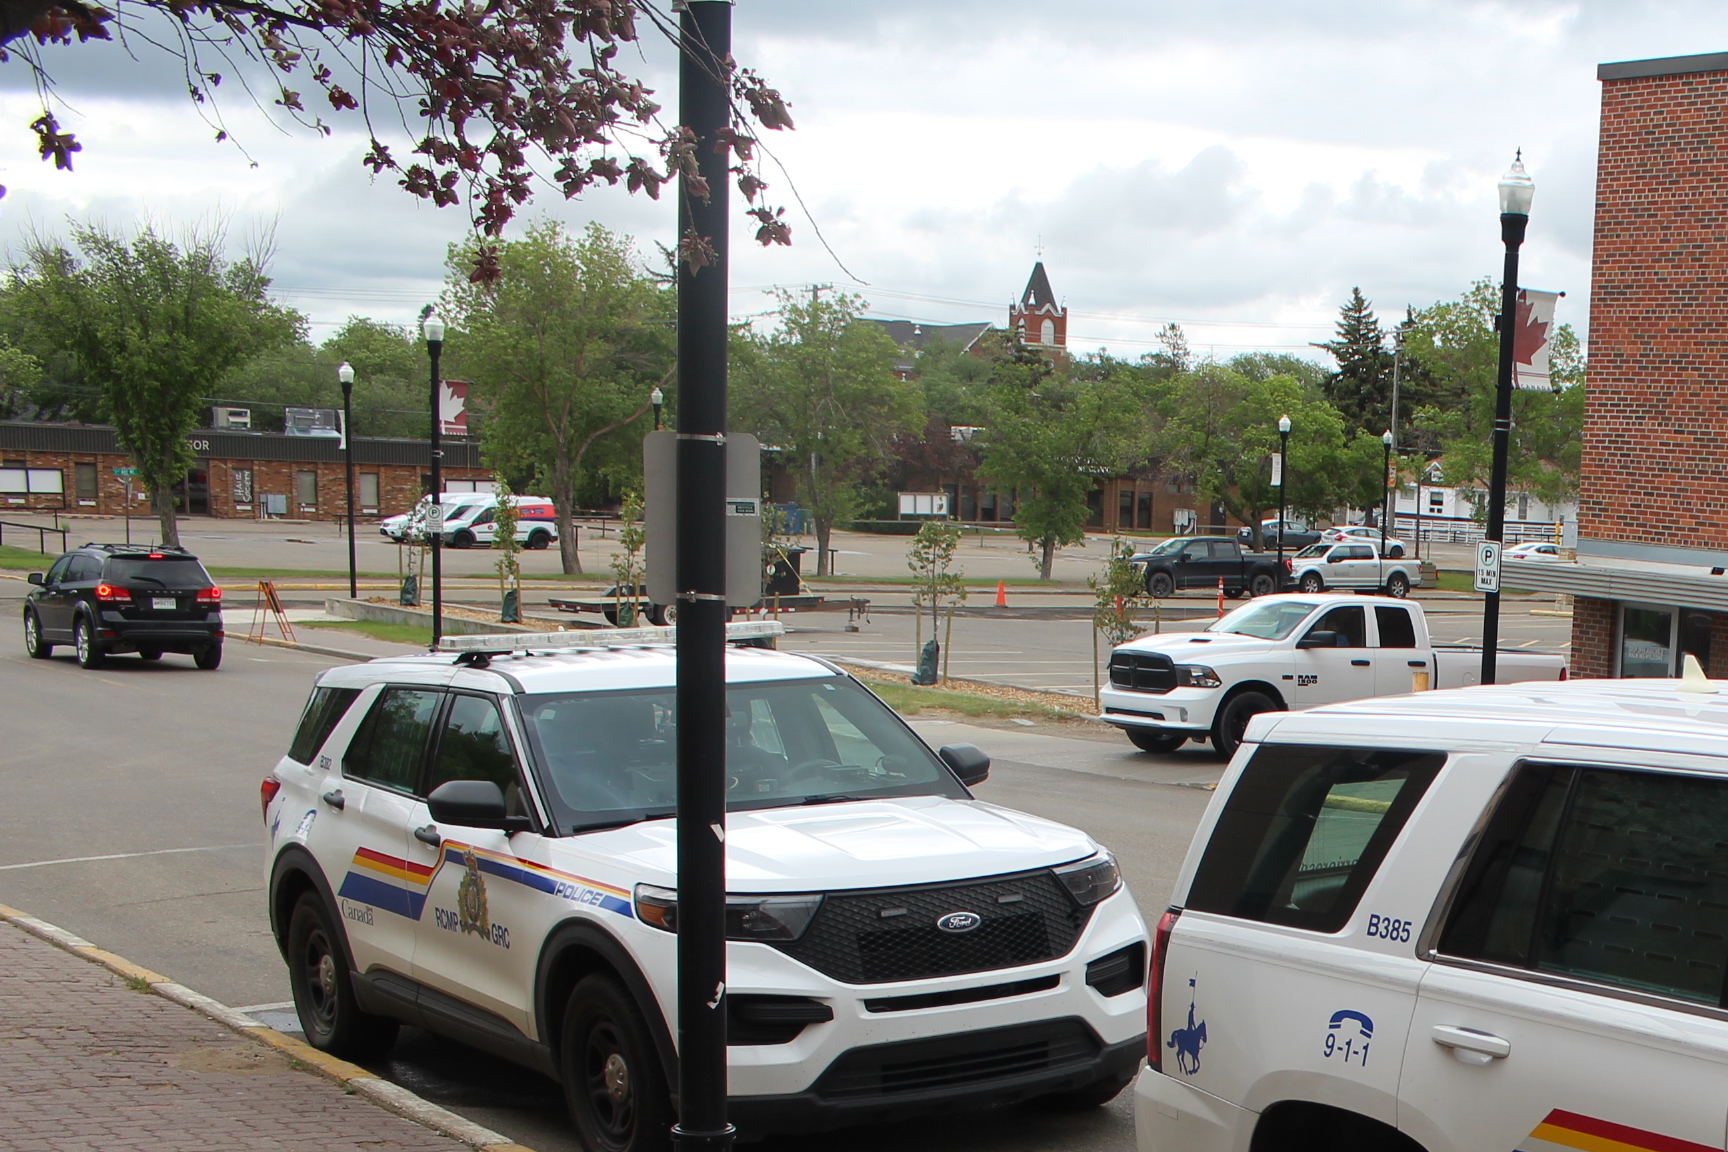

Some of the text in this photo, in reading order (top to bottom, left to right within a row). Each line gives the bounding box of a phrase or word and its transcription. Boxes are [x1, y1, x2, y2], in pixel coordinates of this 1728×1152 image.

[1520, 383, 1550, 391] CANADA
[1481, 577, 1492, 585] MAX
[1486, 569, 1496, 577] MIN
[555, 881, 604, 906] POLICE
[341, 898, 374, 926] Canada
[949, 916, 971, 928] Ford
[435, 907, 510, 949] RCMP GRC
[1367, 913, 1412, 943] B385
[1323, 1033, 1369, 1067] 9-1-1
